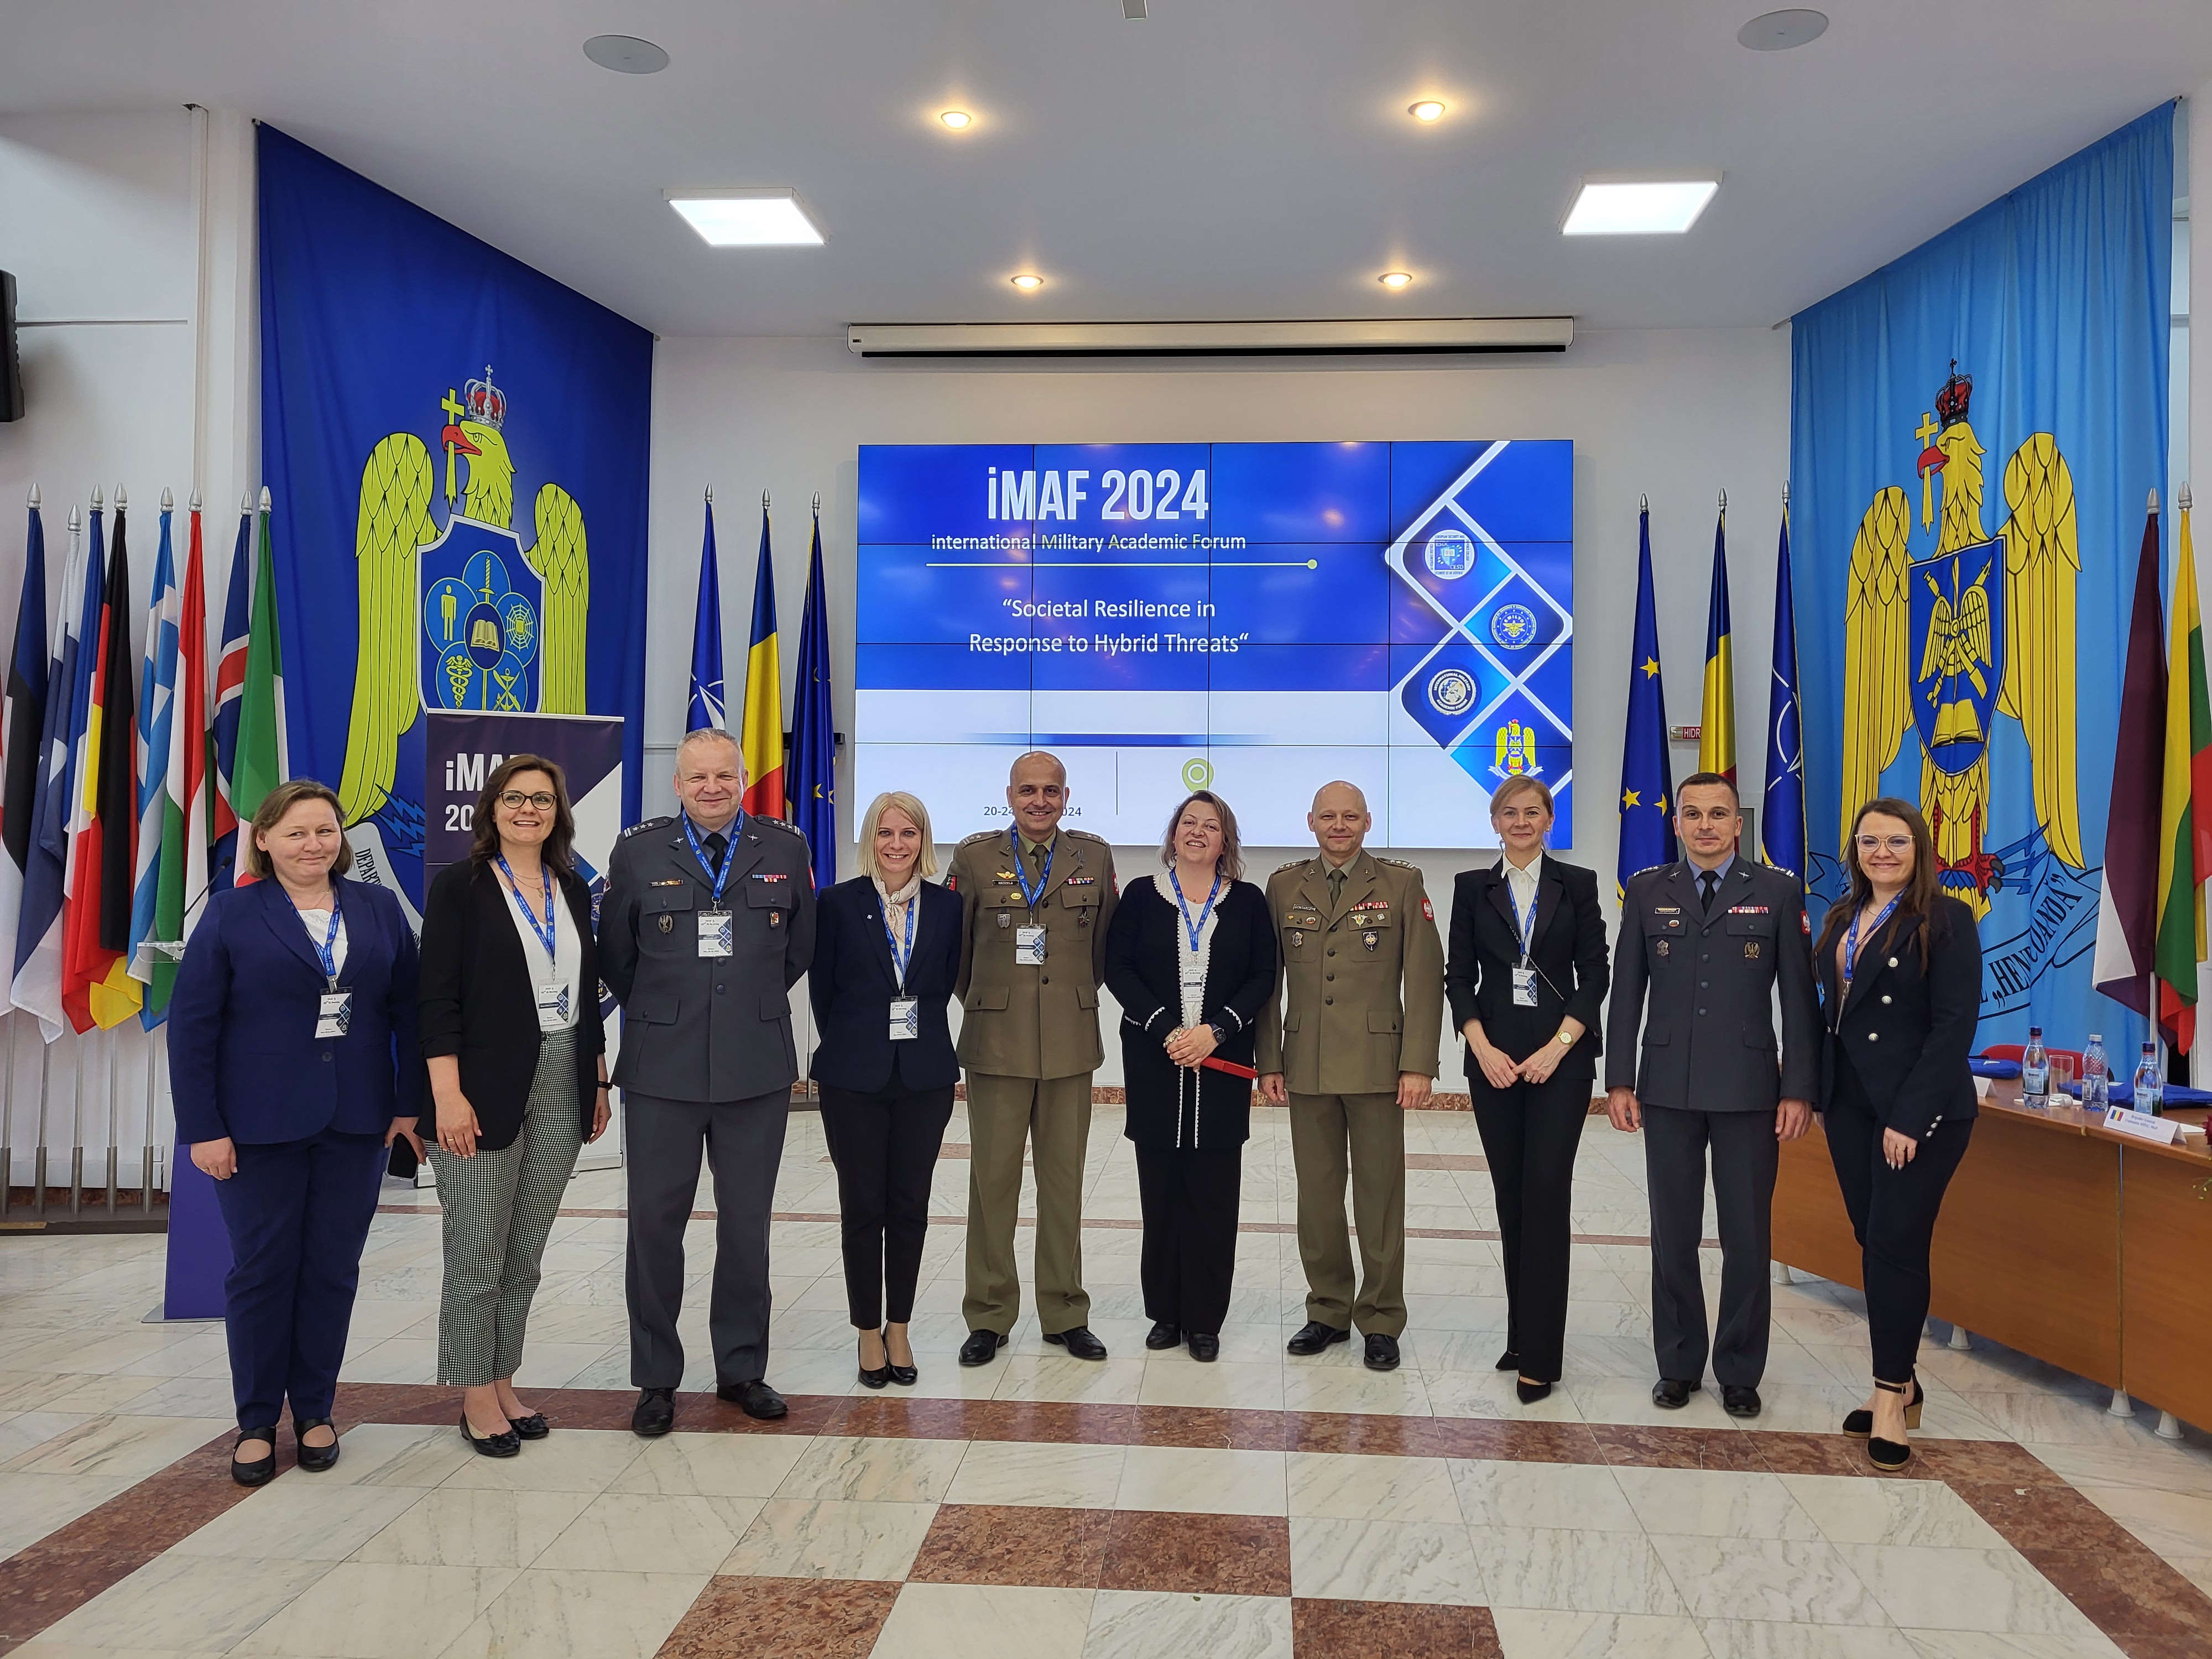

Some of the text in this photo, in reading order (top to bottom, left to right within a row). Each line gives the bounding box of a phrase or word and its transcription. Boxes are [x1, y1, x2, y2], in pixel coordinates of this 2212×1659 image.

[988, 467, 1209, 520] iMAF 2024
[932, 533, 1246, 553] international Military Academic Forum
[1003, 598, 1215, 618] “Societal Resilience in
[970, 634, 1062, 656] Response
[1067, 635, 1088, 652] to
[1095, 633, 1158, 656] Hybrid
[1684, 728, 1701, 738] HIDR
[445, 804, 475, 831] 20
[1062, 807, 1082, 816] 024
[354, 847, 383, 886] DEPART
[1987, 946, 2032, 1009] „HEN
